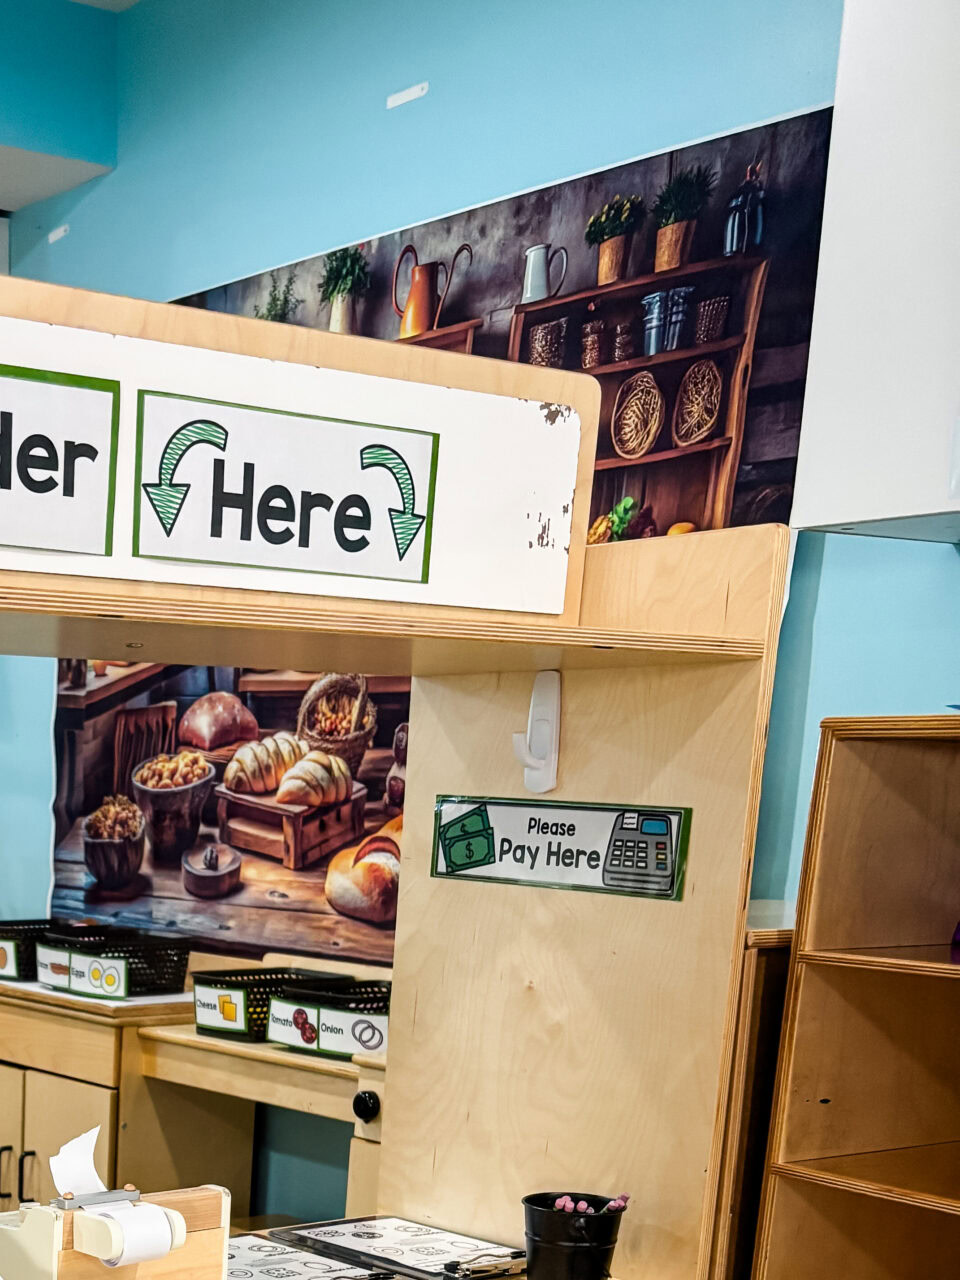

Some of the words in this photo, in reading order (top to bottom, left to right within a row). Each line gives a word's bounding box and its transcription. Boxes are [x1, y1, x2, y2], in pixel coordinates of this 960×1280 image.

[209, 458, 372, 553] Here
[527, 817, 576, 837] Please
[498, 837, 540, 870] Pay
[545, 841, 601, 870] Here
[196, 999, 218, 1011] Cheese
[270, 1013, 293, 1028] Tomato
[320, 1022, 344, 1035] Onion
